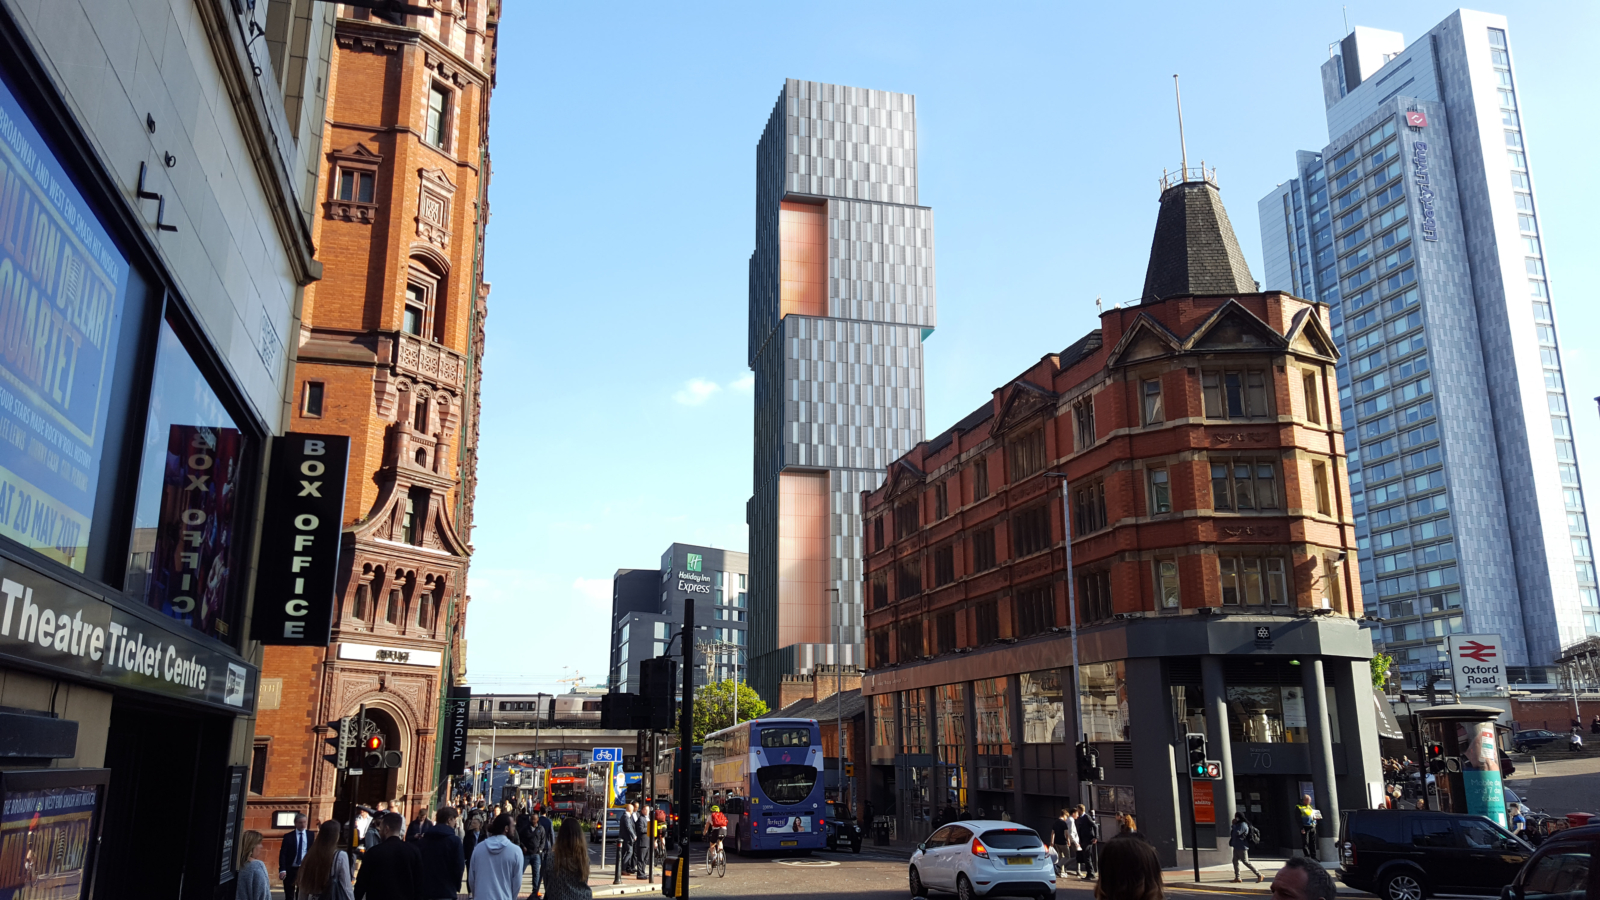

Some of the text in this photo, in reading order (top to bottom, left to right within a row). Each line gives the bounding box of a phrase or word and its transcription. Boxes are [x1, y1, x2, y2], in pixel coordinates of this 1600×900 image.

[0, 106, 37, 172] BROADWAY
[35, 159, 50, 189] AND
[49, 175, 66, 211] WEST
[64, 197, 77, 226] END
[1413, 140, 1438, 242] Liberty Living
[0, 257, 82, 411] QUARTET
[13, 399, 31, 424] STARS
[30, 411, 45, 435] MADE
[13, 490, 32, 534] 20
[31, 499, 58, 546] MAY
[56, 514, 81, 557] 2017
[283, 439, 326, 638] BOX OFFICE
[678, 571, 710, 583] Holiday Inn
[678, 580, 711, 594] Express
[1, 577, 207, 690] Theatre Ticket Centre
[1461, 665, 1499, 675] Oxford
[1467, 675, 1496, 685] Road
[452, 701, 466, 760] PRINCIPAL
[1250, 752, 1272, 769] 70
[1470, 778, 1494, 787] Mobile
[1488, 786, 1493, 794] 7
